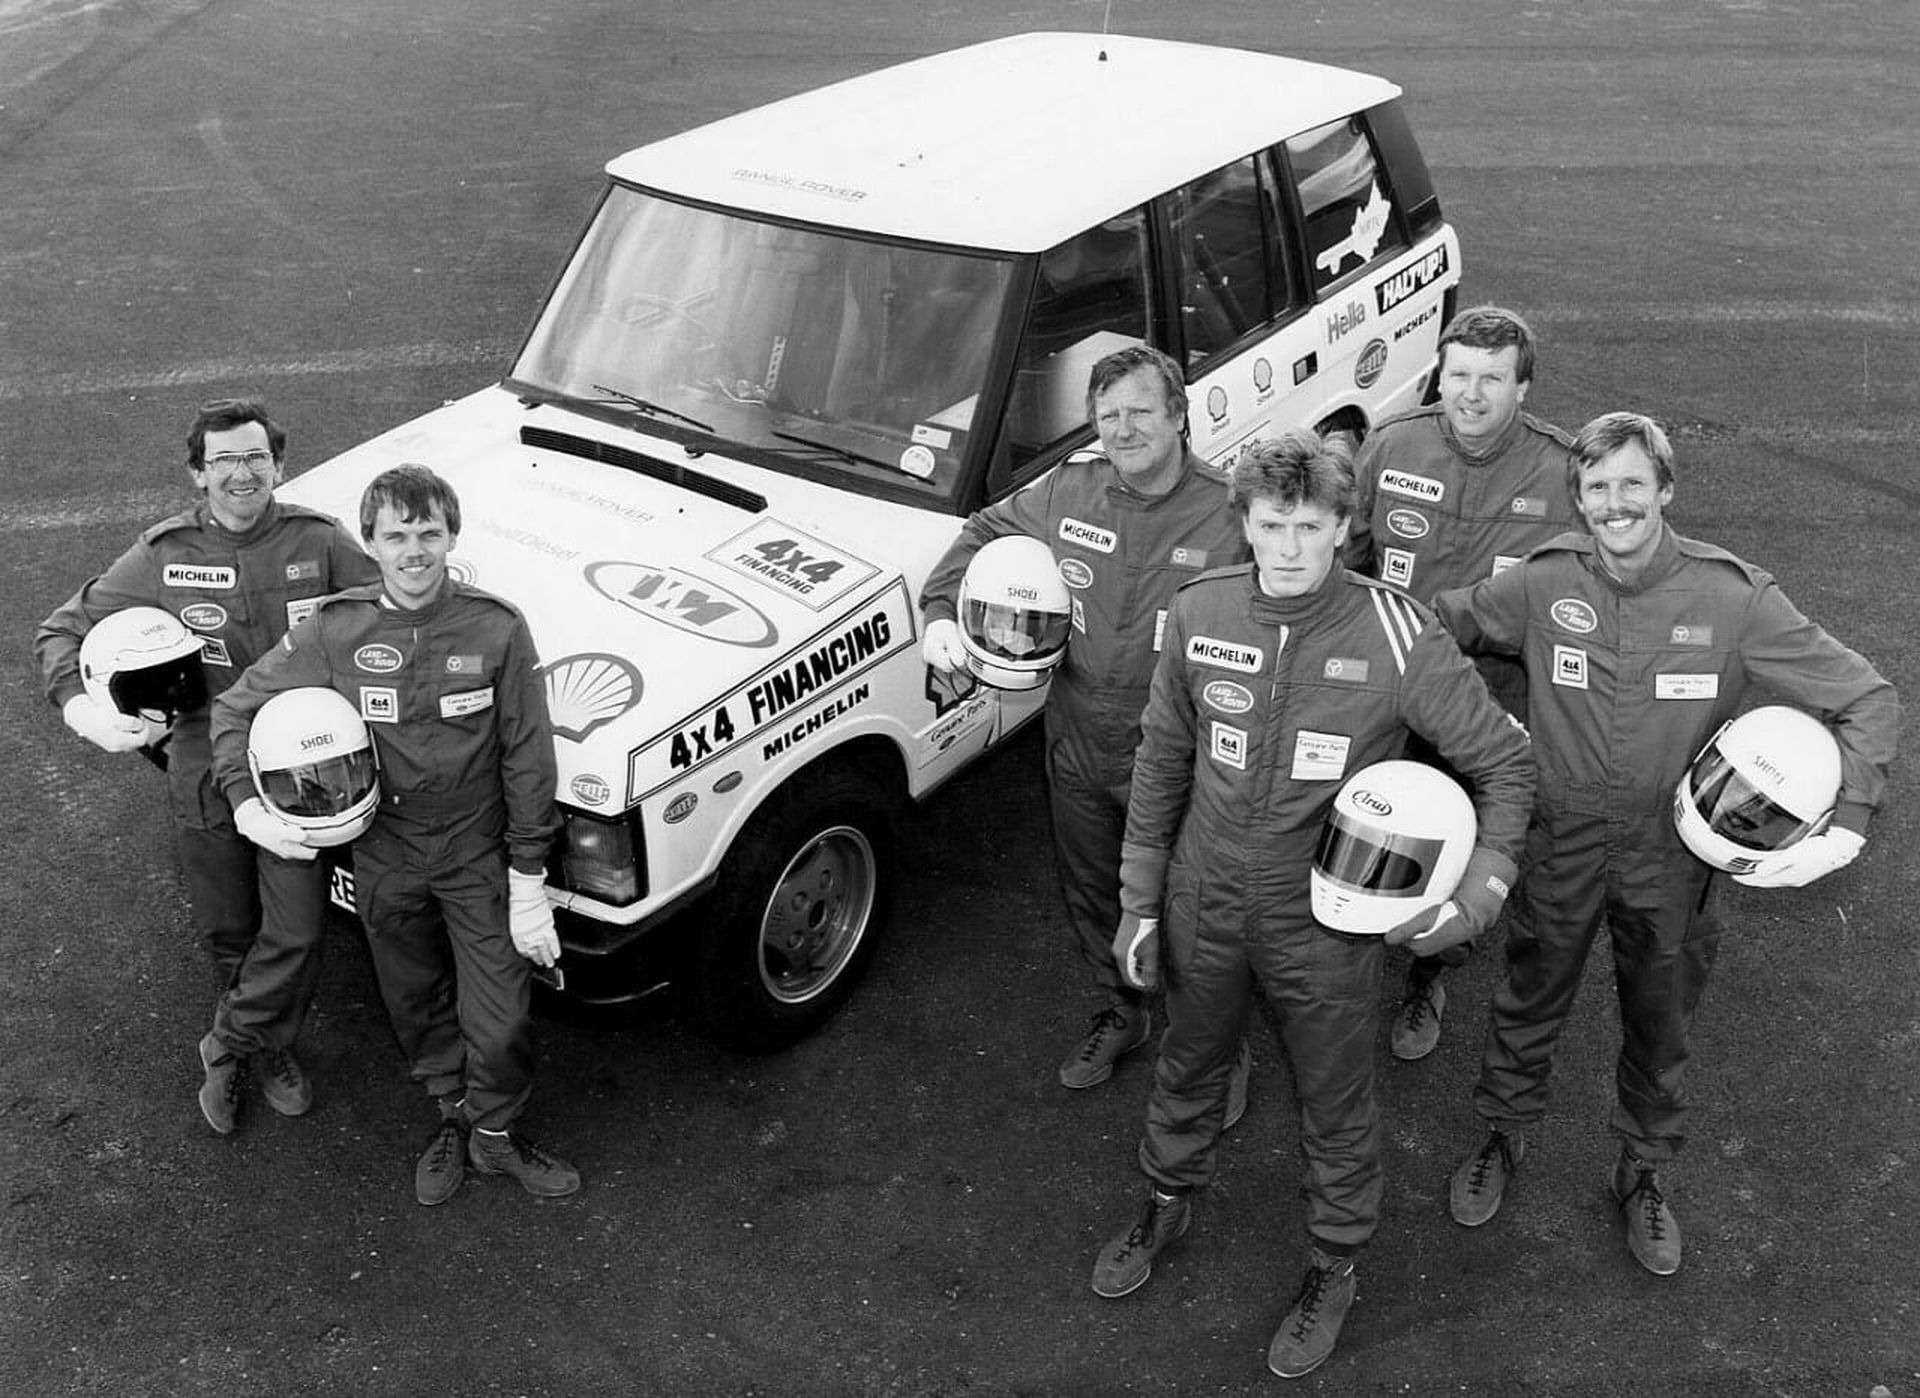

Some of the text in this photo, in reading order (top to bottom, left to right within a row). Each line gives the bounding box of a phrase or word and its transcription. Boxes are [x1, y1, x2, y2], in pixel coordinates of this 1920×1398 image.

[800, 181, 869, 201] ROVER
[1327, 301, 1365, 345] Hella
[1394, 304, 1438, 342] MICHELIN
[1383, 474, 1440, 497] MICHELIN
[1063, 523, 1114, 547] MICHELIN
[168, 570, 230, 583] MICHELIN
[733, 554, 815, 595] FINANCING
[1007, 587, 1038, 601] SHOEI
[1192, 642, 1257, 667] MICHELIN
[747, 611, 891, 726] FINANCING
[763, 682, 870, 761] MICHELIN
[300, 733, 335, 751] SHOEI
